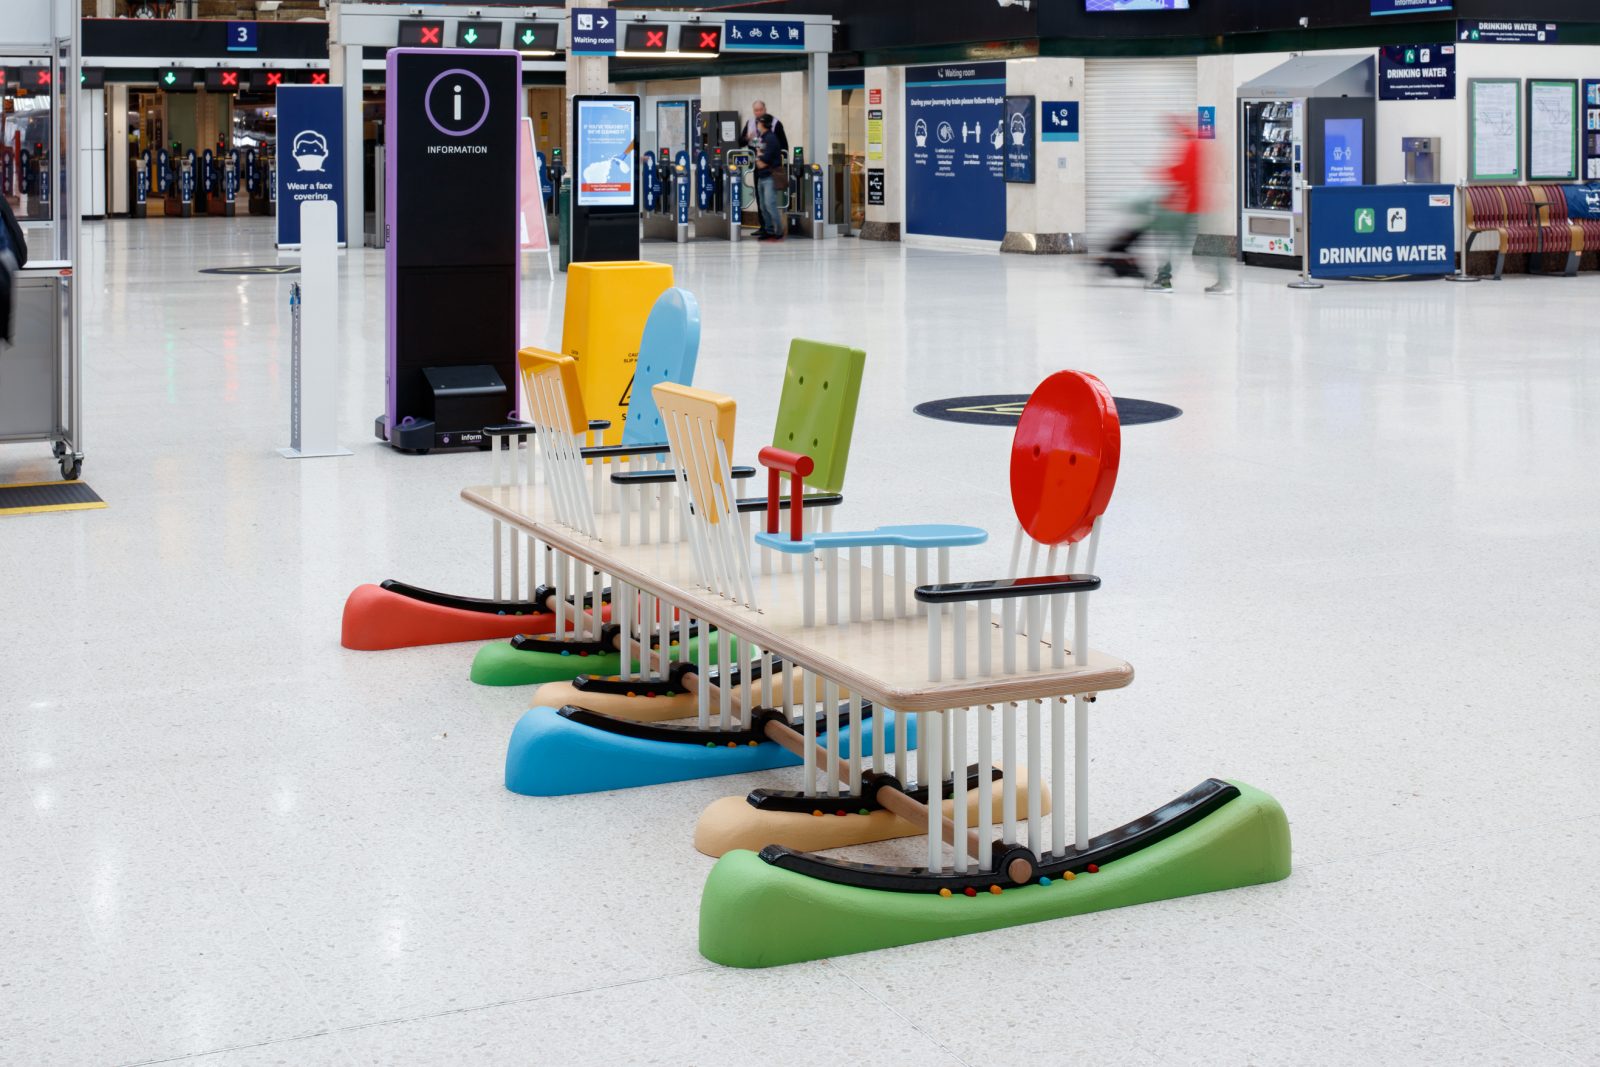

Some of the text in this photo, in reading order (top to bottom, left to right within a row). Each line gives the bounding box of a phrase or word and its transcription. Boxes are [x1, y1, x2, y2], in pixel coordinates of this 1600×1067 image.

[1478, 22, 1537, 31] DRINKING WATER
[237, 26, 248, 42] 3
[574, 36, 597, 45] Waiting
[945, 69, 976, 78] Waiting room
[1387, 67, 1447, 79] DRINKING WATER
[427, 145, 488, 154] INFORMATION
[286, 182, 309, 190] Wear
[315, 181, 333, 190] face
[293, 192, 329, 201] covering
[1319, 244, 1447, 265] DRINKING WATER
